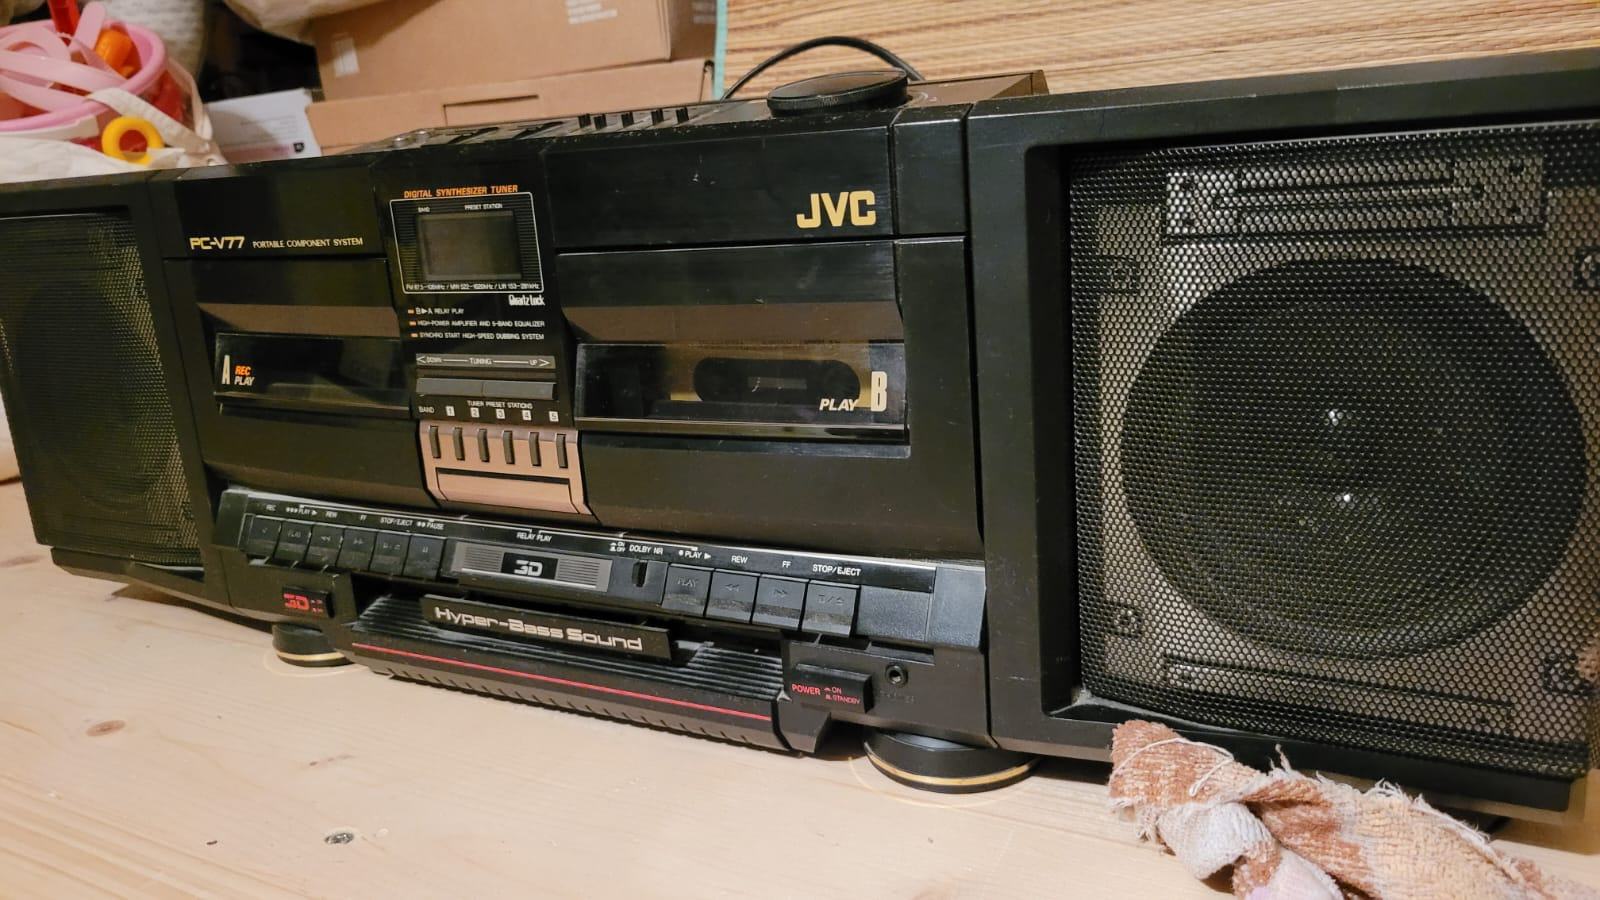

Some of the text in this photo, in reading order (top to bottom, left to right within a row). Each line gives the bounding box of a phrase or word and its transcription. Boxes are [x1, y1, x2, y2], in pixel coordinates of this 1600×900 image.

[404, 185, 519, 198] DIGITAL SYNTHESIZER TUNER
[796, 190, 877, 229] JVC
[189, 236, 245, 250] PC-V77
[252, 237, 364, 249] PORTABLE COMPONENT SYSTEM
[508, 294, 530, 306] Quartz
[469, 357, 492, 365] TUNING
[222, 354, 231, 385] A
[234, 365, 251, 376] REC
[234, 375, 255, 386] PLAY
[870, 371, 888, 412] B
[418, 406, 435, 414] BAND
[467, 400, 533, 410] TUNER PRESET STATIONS
[819, 398, 860, 412] PLAY
[266, 504, 276, 513] REC
[298, 508, 311, 517] PLAY
[426, 521, 444, 531] PAUSE
[517, 531, 552, 543] RELAY PLAY
[629, 544, 664, 556] DOLBY NR
[684, 550, 702, 560] PLAY
[731, 555, 748, 564] REW
[782, 560, 791, 569] FF
[513, 559, 543, 577] 3D
[812, 563, 862, 577] STOP/EJECT
[434, 606, 644, 651] Hyper-Bass Sound
[791, 683, 821, 696] POWER
[831, 686, 842, 695] ON
[833, 694, 861, 705] STANDBY
